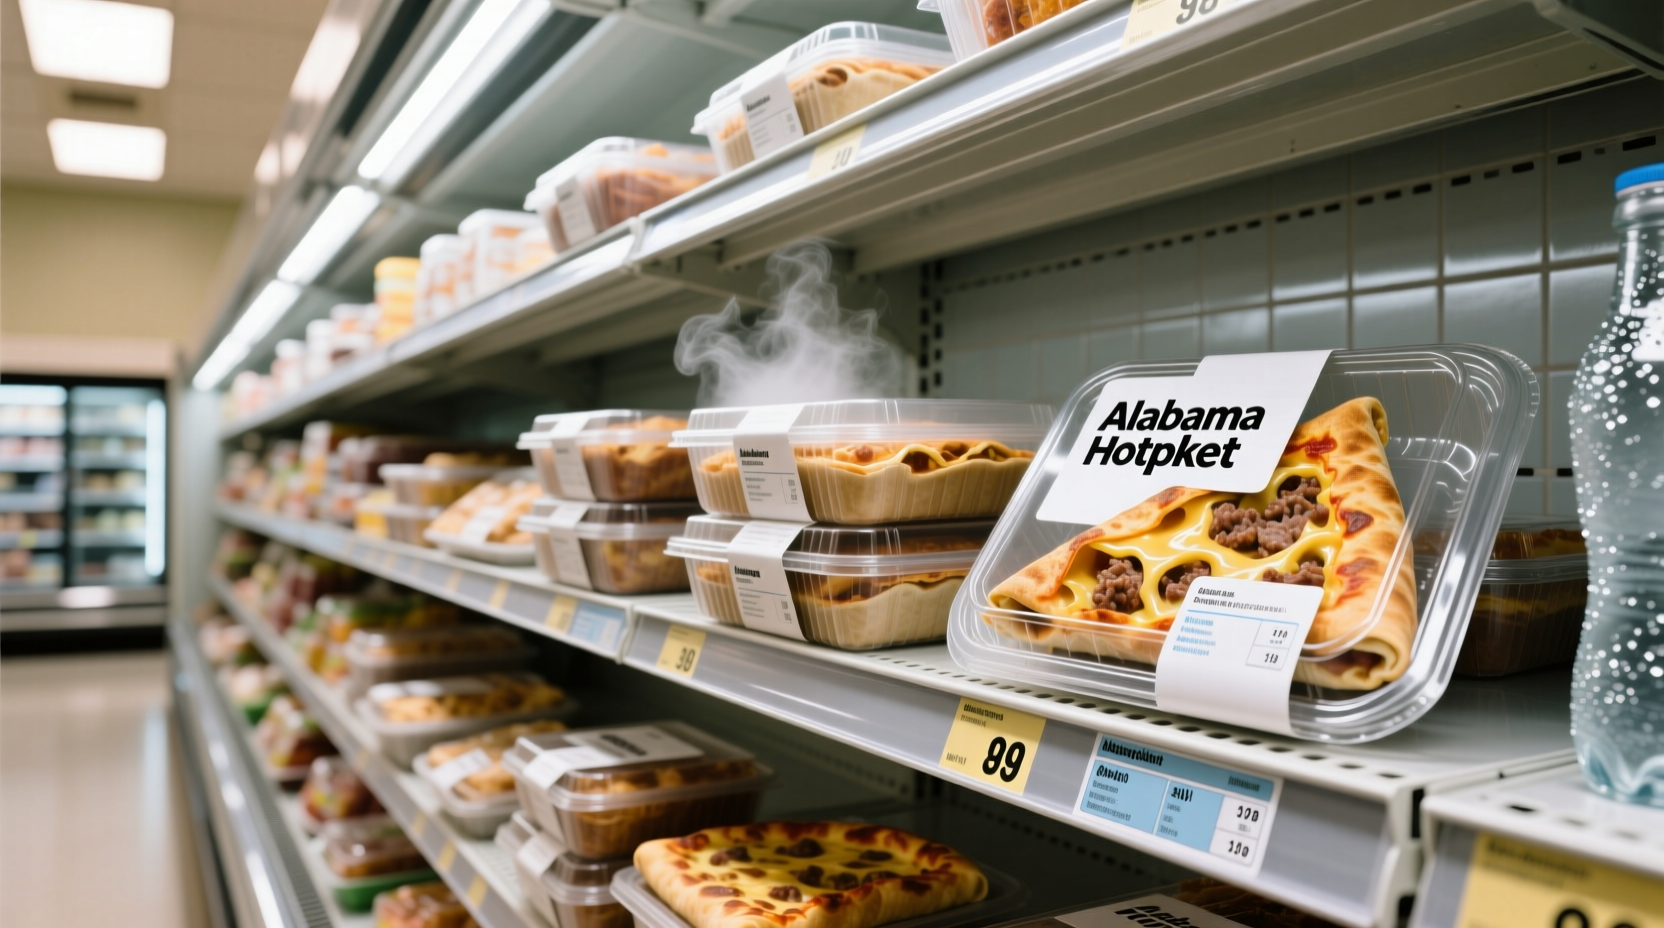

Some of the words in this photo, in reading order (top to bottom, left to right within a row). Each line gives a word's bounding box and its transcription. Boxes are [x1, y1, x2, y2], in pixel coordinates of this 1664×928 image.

[1097, 399, 1266, 431] Alabama
[1082, 434, 1242, 476] Hotpket
[982, 736, 1026, 783] 89
